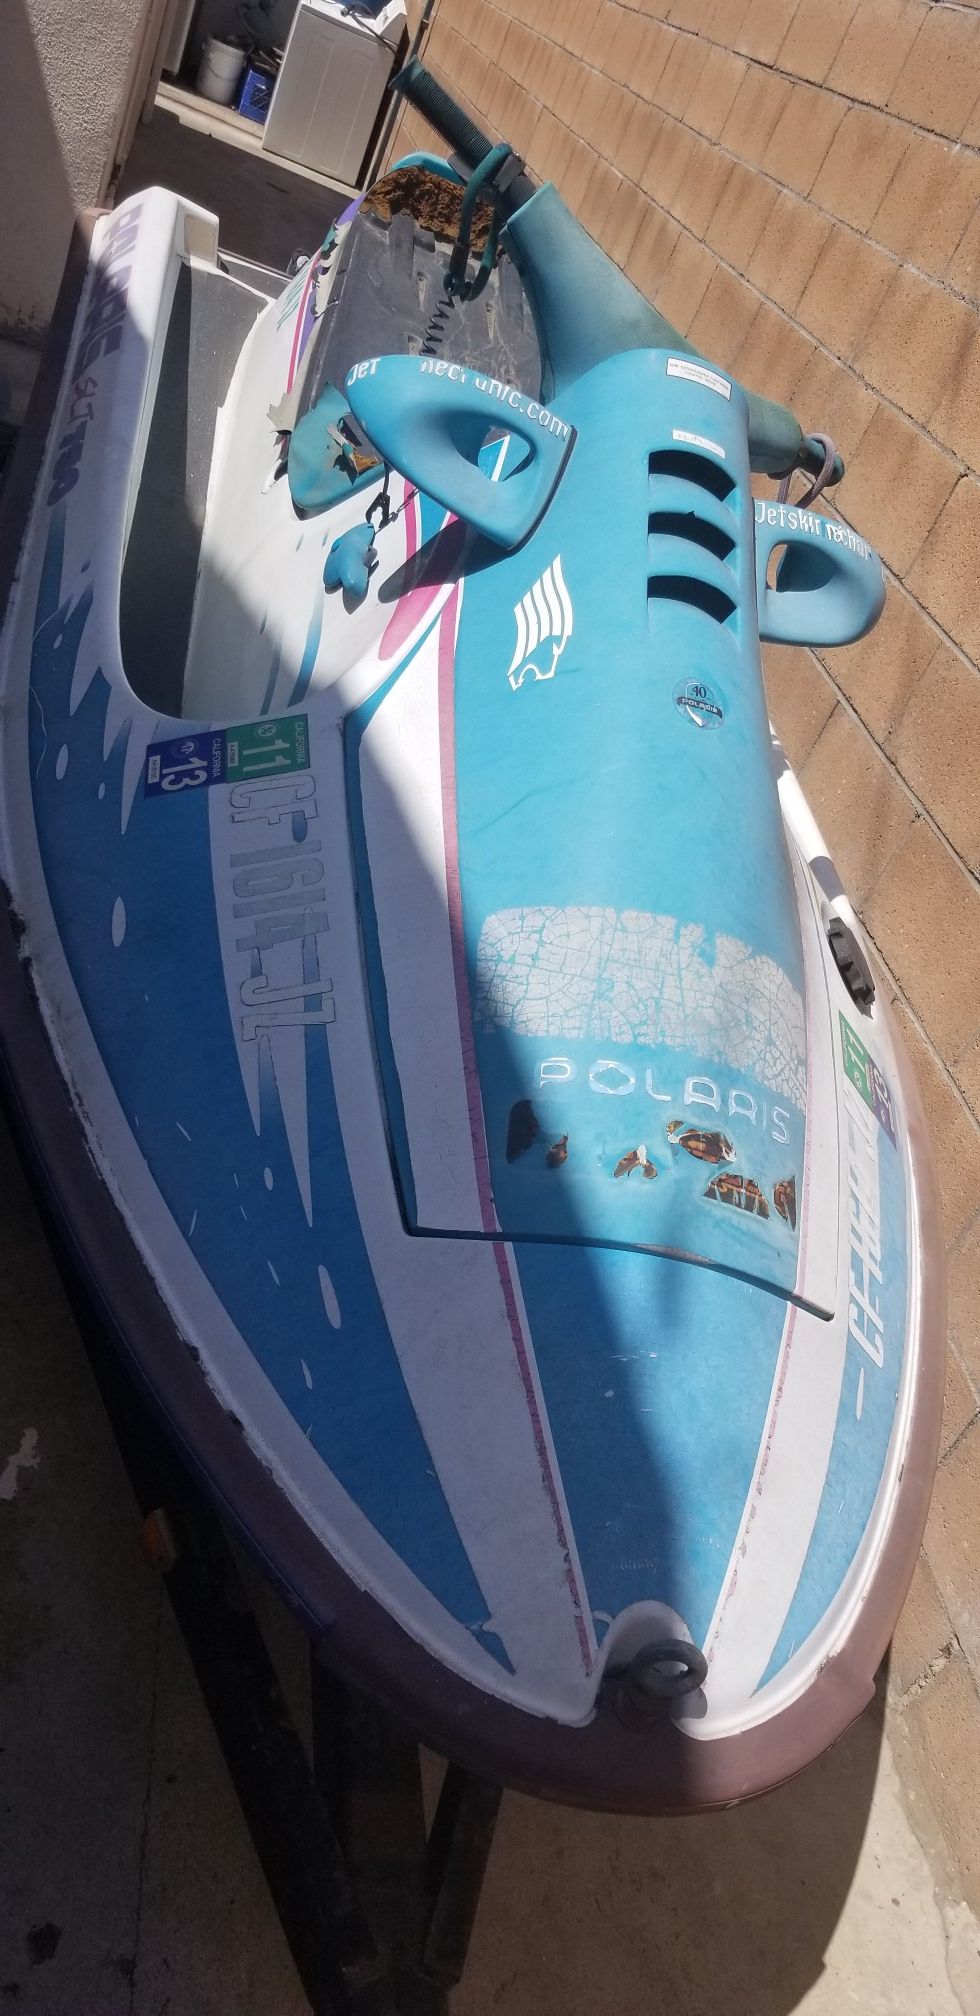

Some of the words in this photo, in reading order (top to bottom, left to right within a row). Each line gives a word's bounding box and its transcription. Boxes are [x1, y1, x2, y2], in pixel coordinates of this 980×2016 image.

[71, 203, 144, 386] POLARIS
[69, 377, 98, 423] SLT
[681, 698, 719, 714] POLARIS
[691, 685, 707, 699] 40
[211, 737, 222, 778] CALIFORNIA
[242, 739, 292, 772] 11
[294, 720, 305, 765] CALIFORNIA
[160, 756, 208, 791] 13
[229, 774, 319, 824] CF
[538, 1056, 791, 1144] POLARIS
